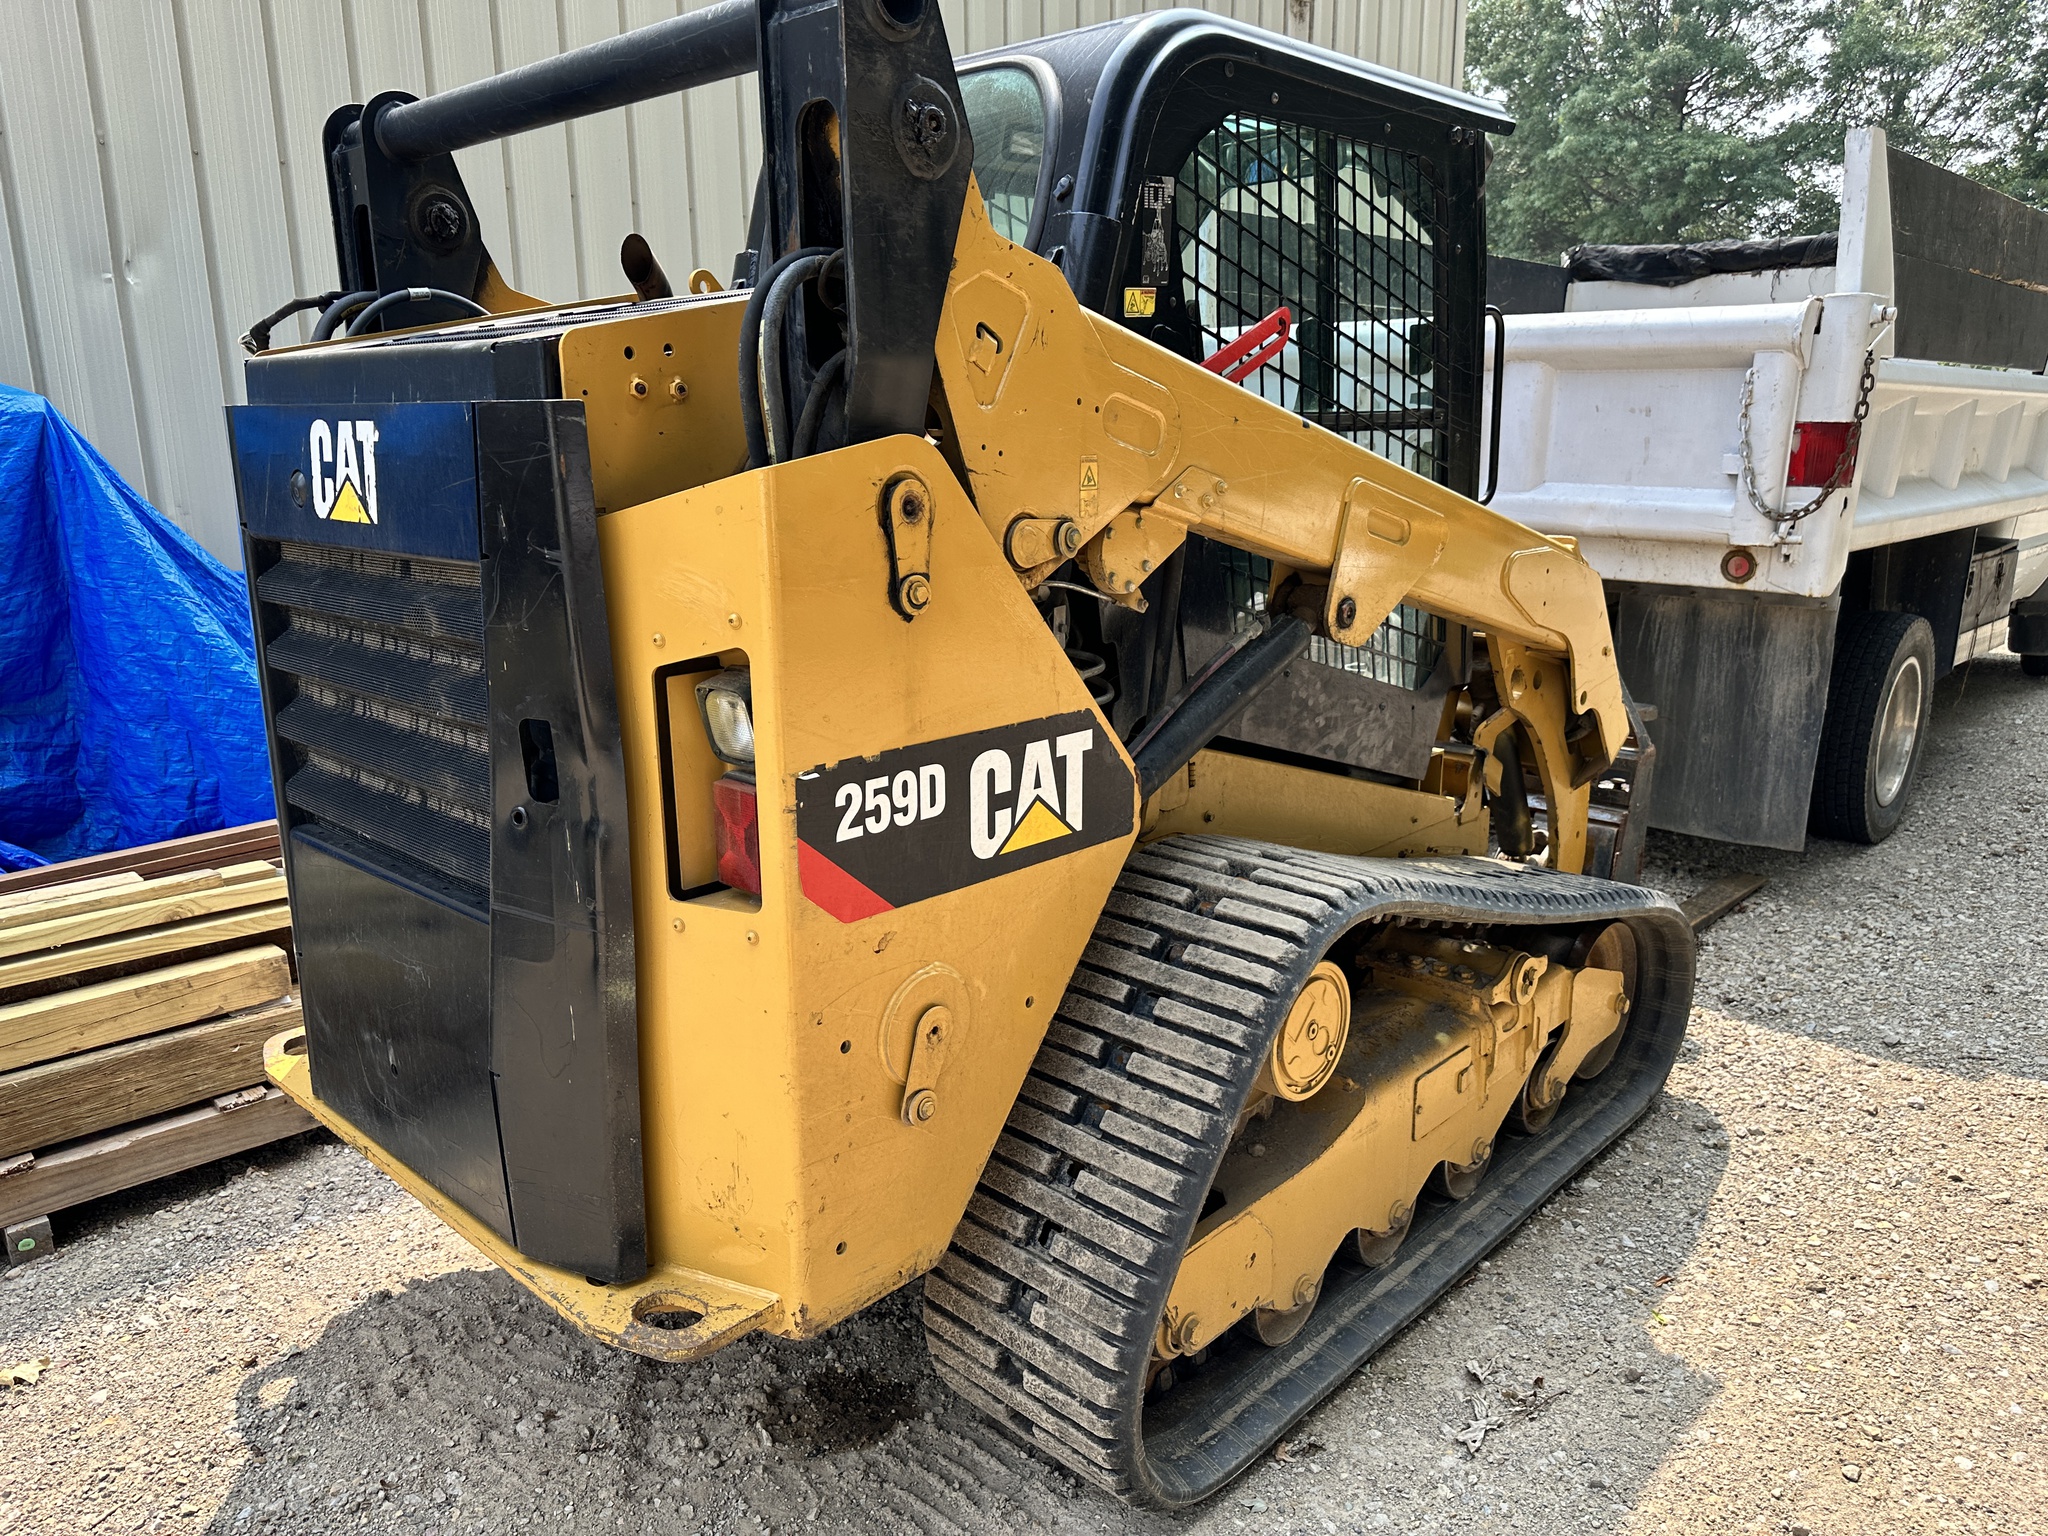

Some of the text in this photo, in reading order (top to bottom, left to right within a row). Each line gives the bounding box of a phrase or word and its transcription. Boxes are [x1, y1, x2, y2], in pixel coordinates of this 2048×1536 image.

[309, 418, 379, 525] CAT
[834, 728, 1093, 860] 259D CAT
